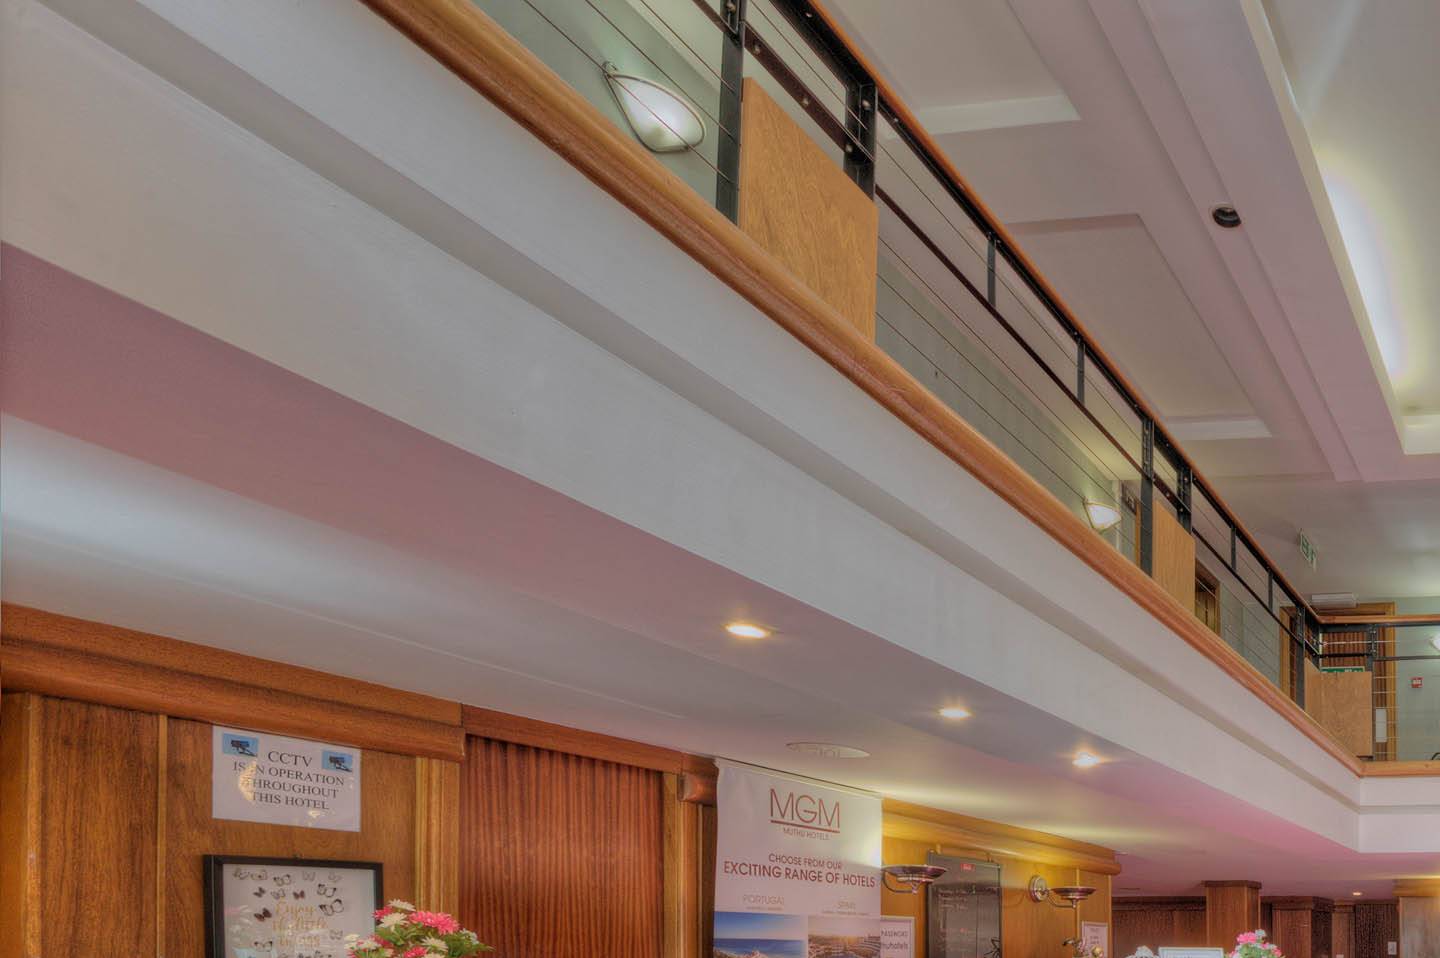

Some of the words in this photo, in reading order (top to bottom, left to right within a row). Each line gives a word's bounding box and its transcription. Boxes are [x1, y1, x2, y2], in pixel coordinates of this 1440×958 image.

[268, 750, 312, 767] CCTV
[233, 761, 246, 771] IS
[268, 767, 345, 786] OPERATION
[252, 791, 281, 804] THIS
[285, 796, 330, 810] HOTEL
[769, 787, 840, 828] MGM
[768, 853, 802, 866] CHOOSE
[803, 856, 825, 868] FROM
[826, 858, 843, 870] OUR
[723, 861, 782, 880] EXCITING
[784, 867, 823, 884] RANGE
[825, 872, 841, 885] OF
[842, 874, 876, 888] HOTELS
